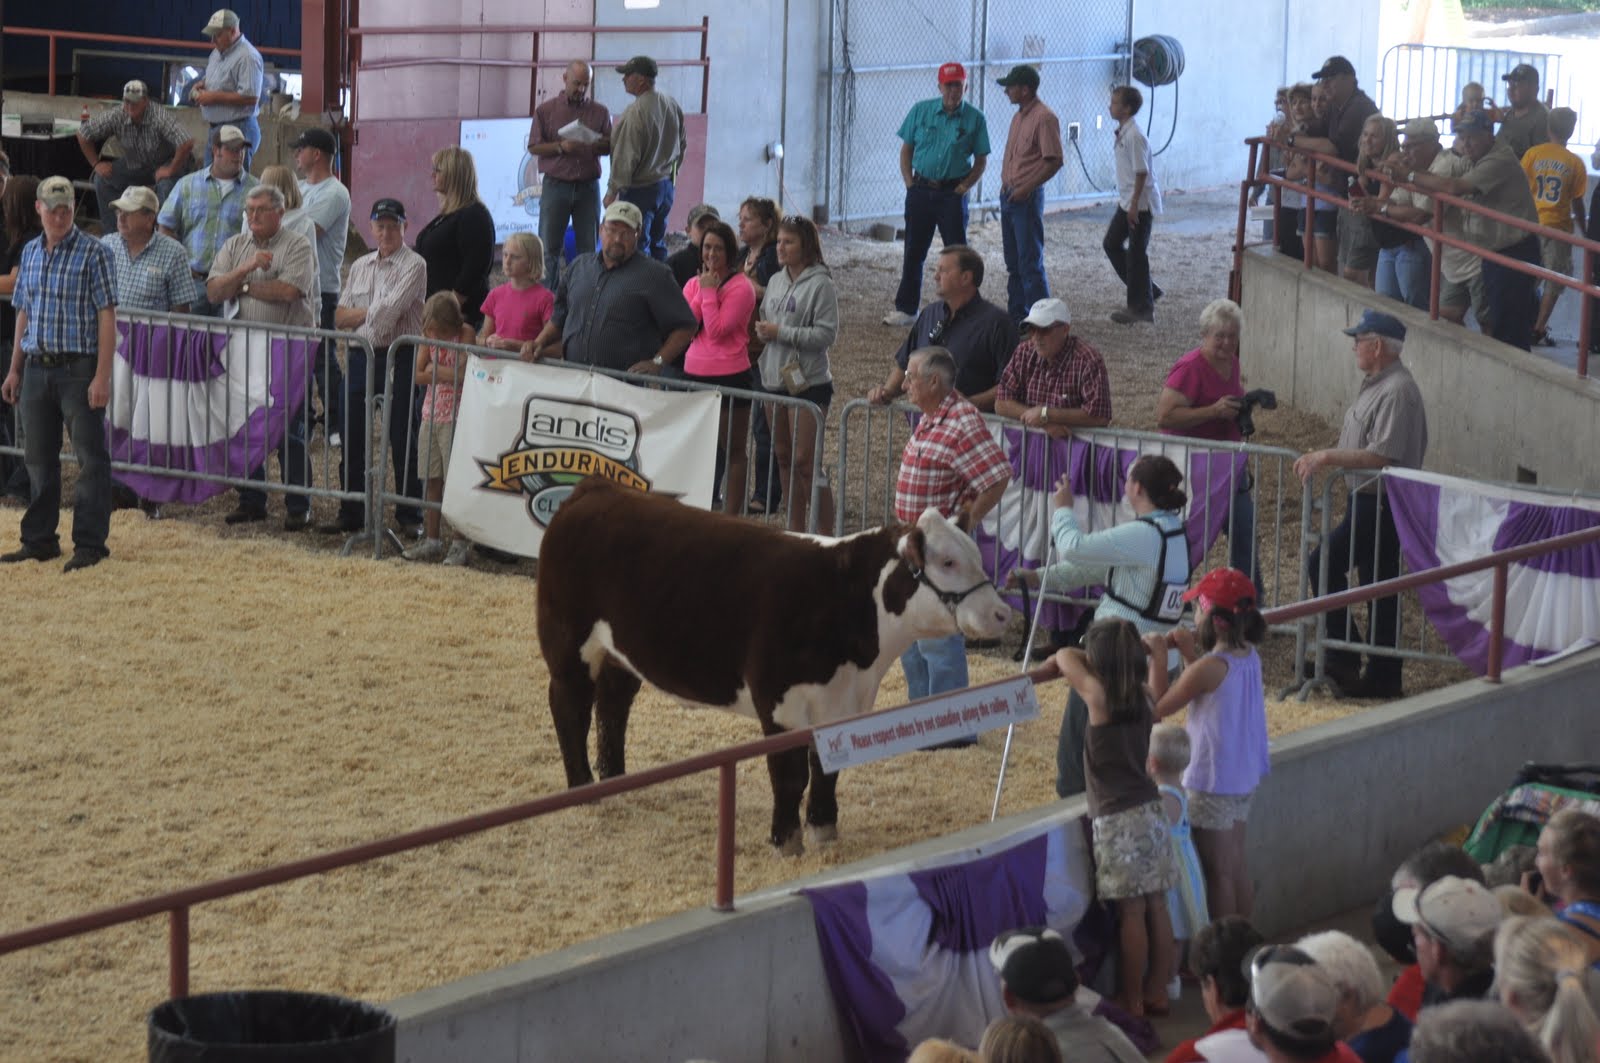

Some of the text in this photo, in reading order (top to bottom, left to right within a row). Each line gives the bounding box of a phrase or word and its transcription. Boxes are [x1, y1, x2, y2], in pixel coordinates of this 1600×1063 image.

[1536, 175, 1561, 202] 13
[531, 412, 629, 447] andis
[851, 734, 873, 750] Please
[873, 726, 896, 745] respect
[896, 723, 915, 738] others
[913, 717, 925, 736] by
[923, 715, 936, 732] not
[935, 709, 961, 727] standing
[962, 705, 980, 722] along
[979, 701, 990, 718] the
